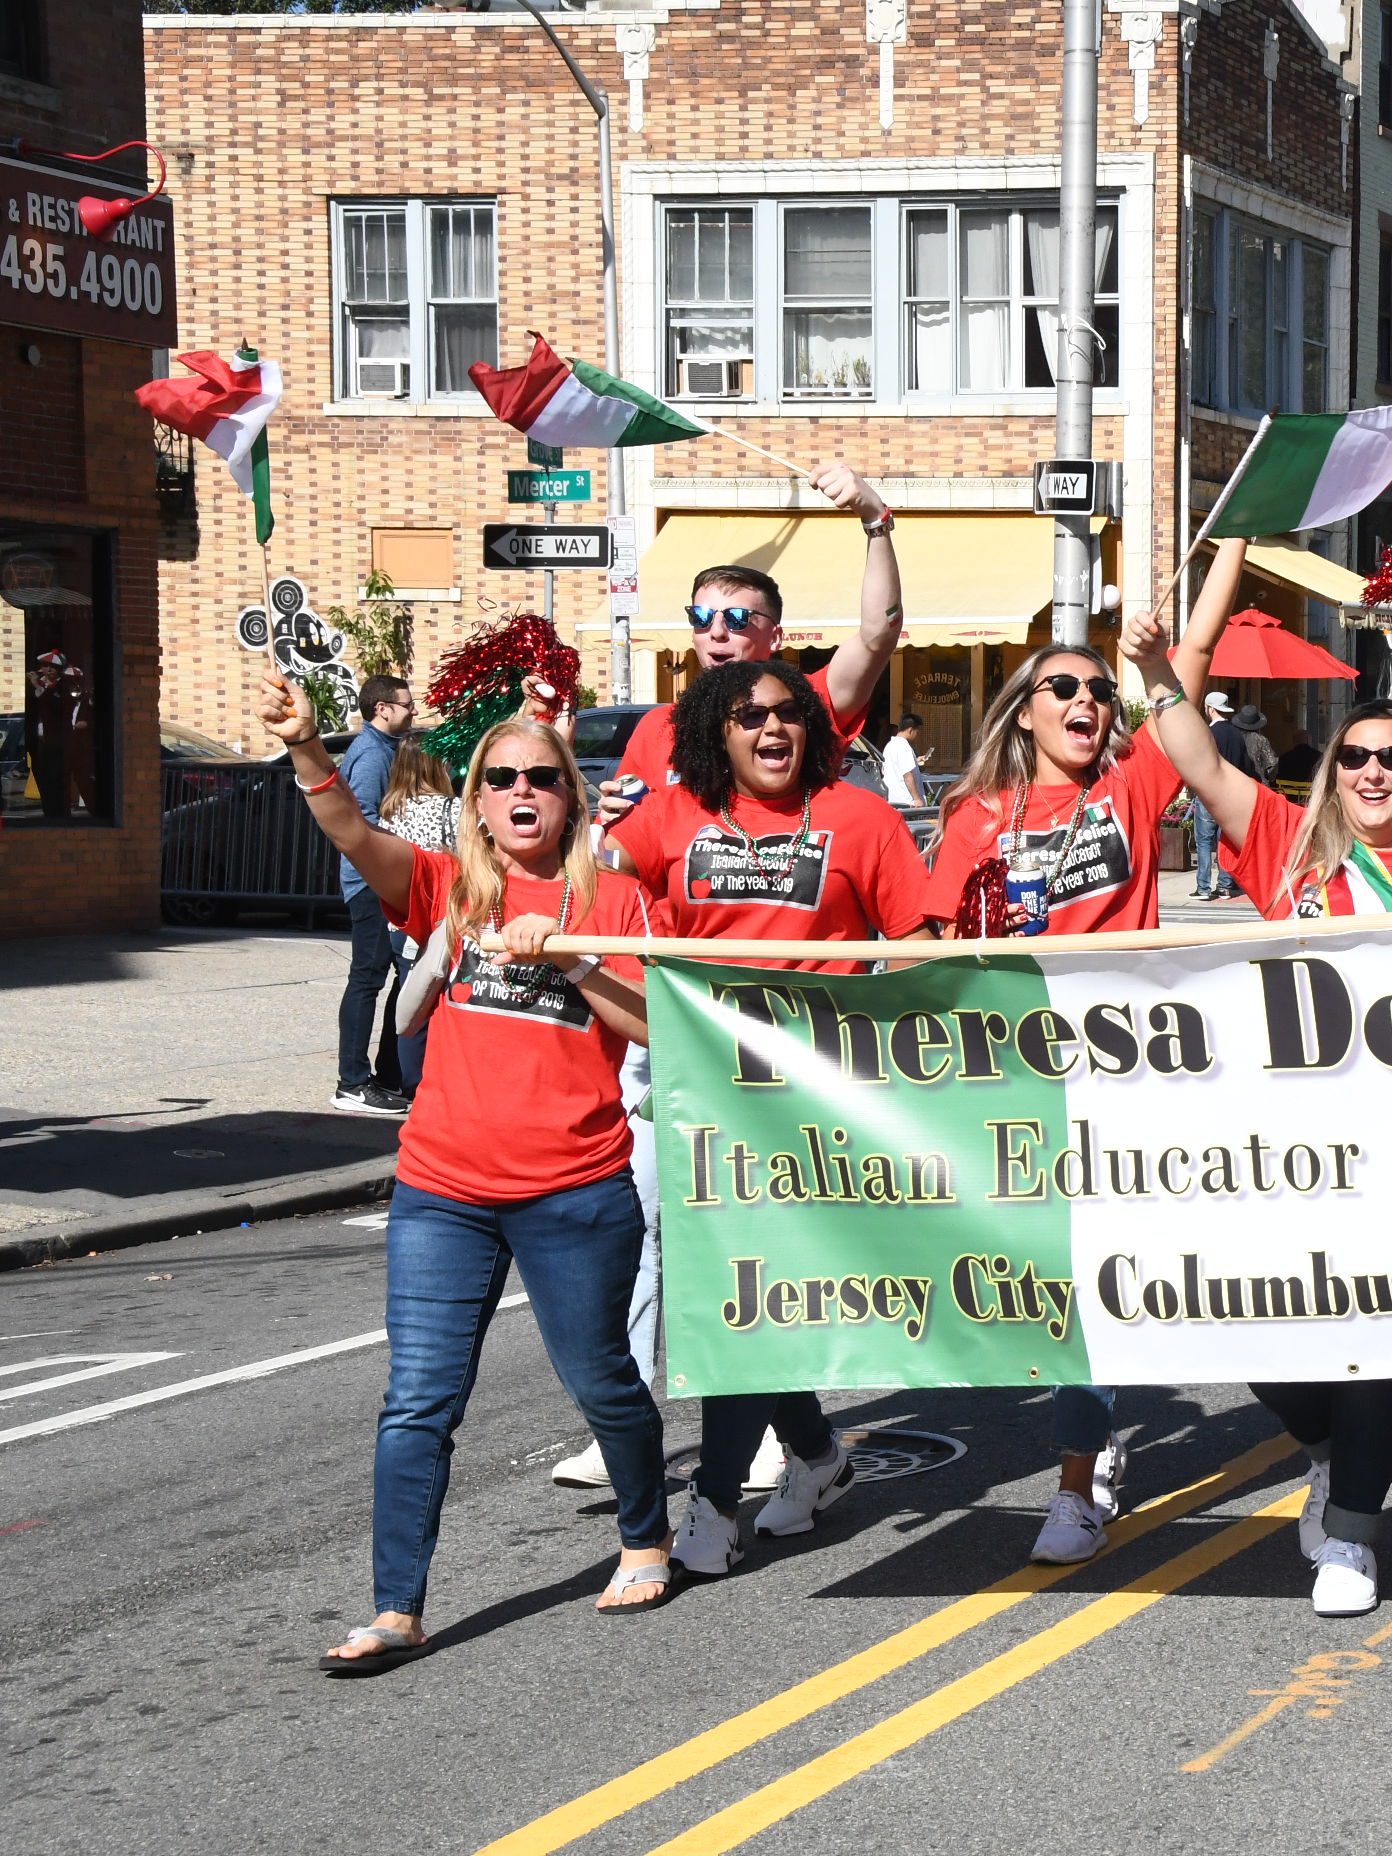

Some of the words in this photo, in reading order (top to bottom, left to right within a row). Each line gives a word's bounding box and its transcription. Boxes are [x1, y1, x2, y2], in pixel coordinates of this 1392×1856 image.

[8, 198, 20, 223] &
[27, 191, 166, 252] RESTRANT
[0, 234, 163, 315] 435.4900
[513, 476, 570, 497] Mercer
[575, 475, 585, 487] St
[1053, 476, 1080, 496] WAY
[509, 538, 544, 555] ONE
[554, 538, 592, 555] WAY
[782, 632, 823, 642] LUNCH
[710, 854, 746, 869] Italian
[759, 843, 823, 860] DeFeice
[1003, 849, 1063, 866] Teres
[1086, 862, 1109, 883] 2019
[538, 990, 566, 1011] 2019
[709, 981, 1215, 1087] Theresa
[681, 1123, 957, 1206] Italian
[984, 1118, 1362, 1204] Educator
[721, 1256, 933, 1342] Jersey
[950, 1252, 1077, 1341] City
